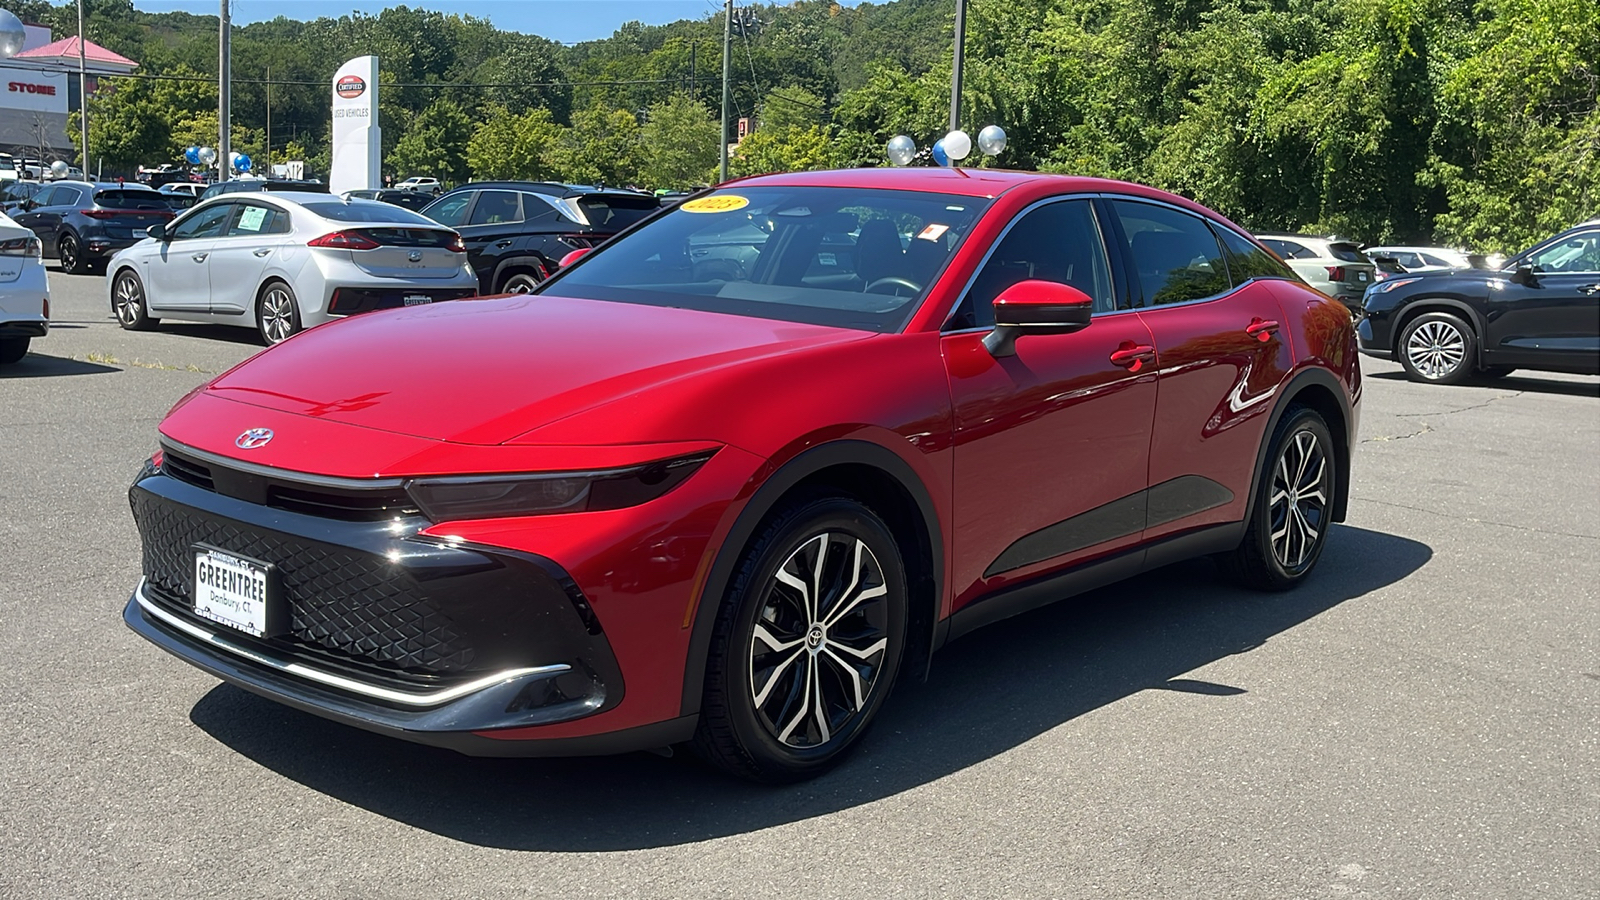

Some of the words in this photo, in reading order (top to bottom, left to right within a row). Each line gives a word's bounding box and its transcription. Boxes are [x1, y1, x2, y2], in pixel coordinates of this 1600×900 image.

[8, 82, 56, 96] STONE
[346, 108, 369, 118] VEHICLES
[199, 561, 264, 603] GREENTREE
[210, 590, 240, 613] Danbury,
[242, 601, 252, 614] CT.
